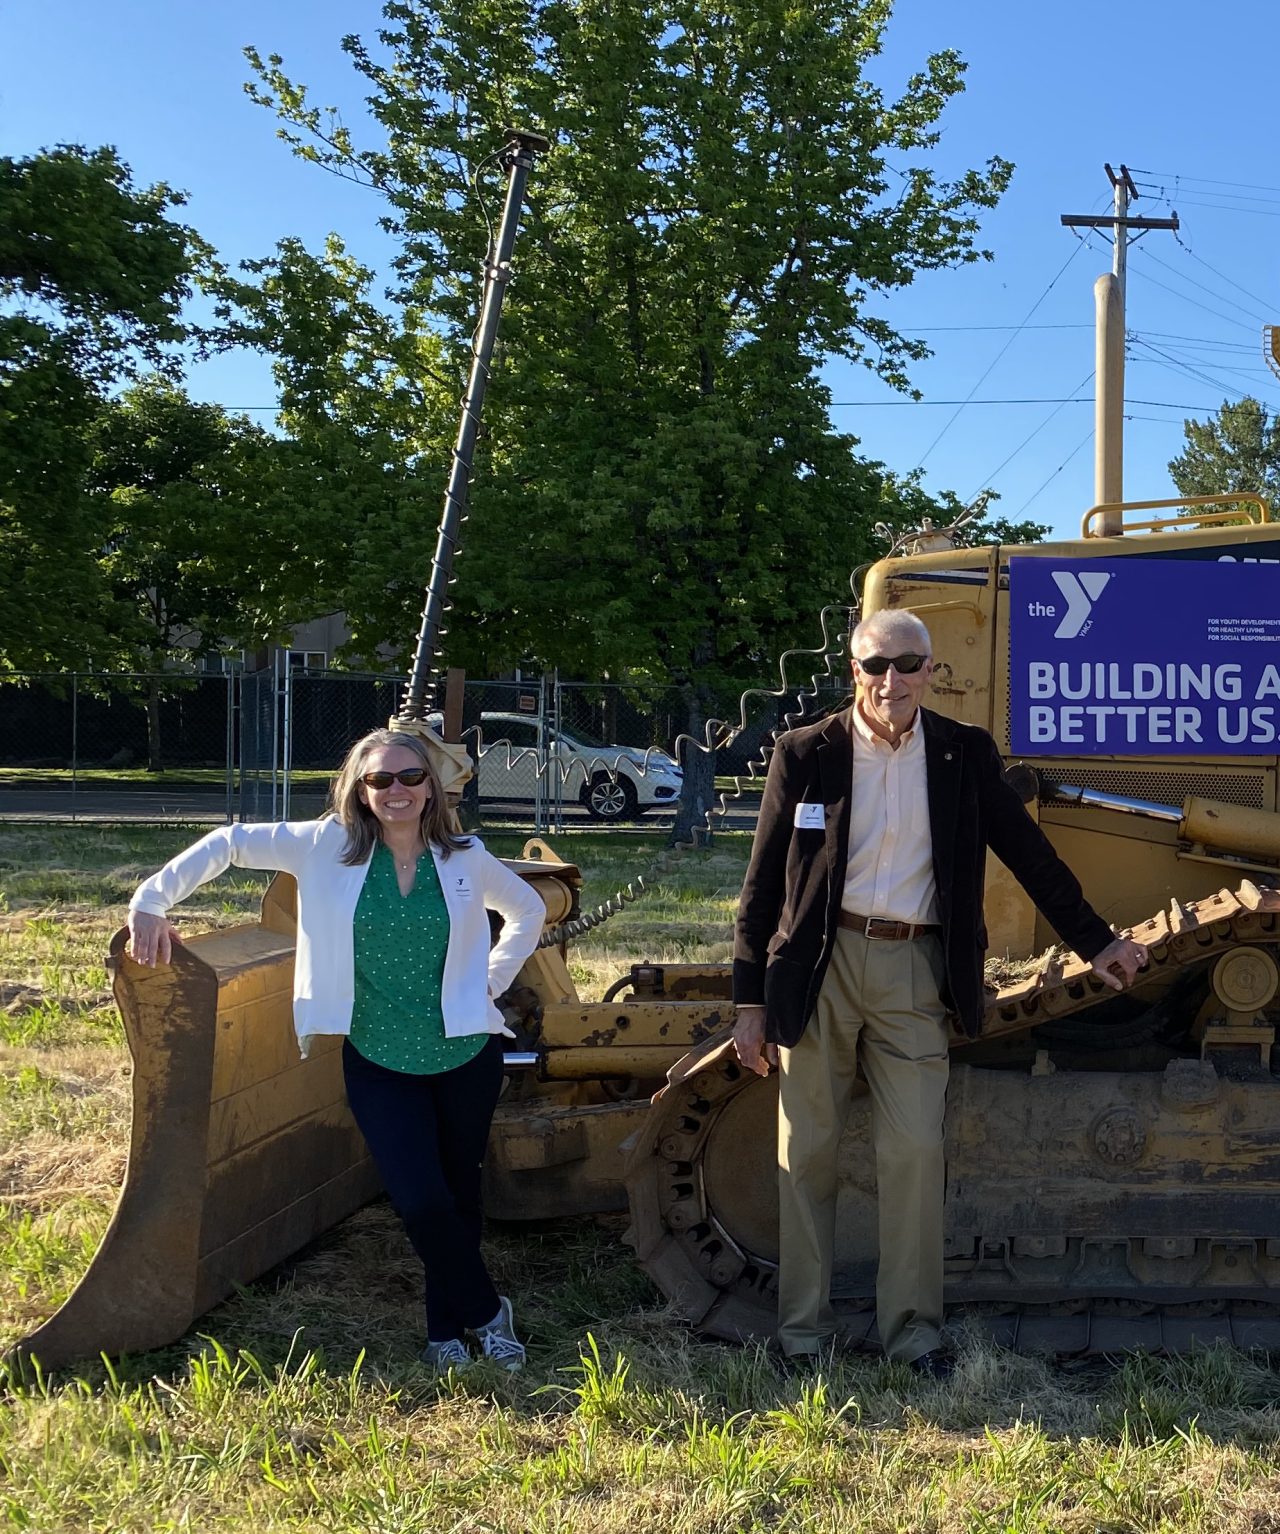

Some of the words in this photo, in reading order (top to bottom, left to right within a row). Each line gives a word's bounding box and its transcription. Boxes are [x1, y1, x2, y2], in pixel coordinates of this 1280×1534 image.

[1028, 601, 1056, 617] the
[1078, 619, 1094, 638] YMCA
[1029, 662, 1242, 700] BUILDING
[1029, 705, 1204, 743] BETTER
